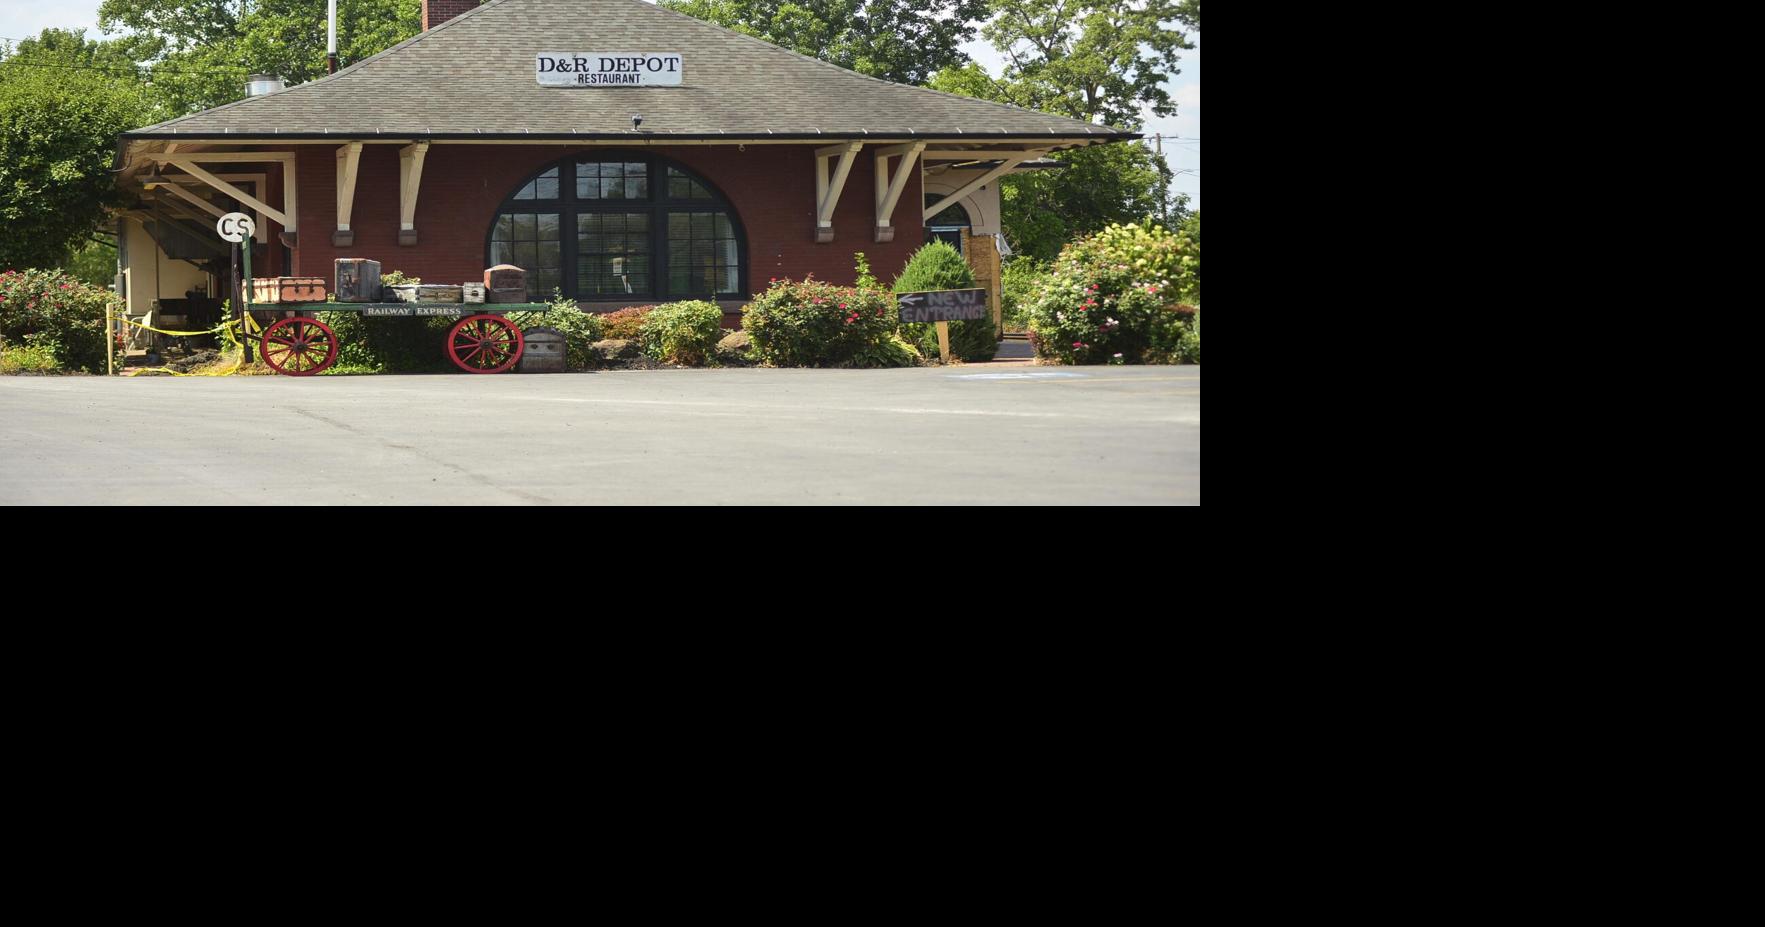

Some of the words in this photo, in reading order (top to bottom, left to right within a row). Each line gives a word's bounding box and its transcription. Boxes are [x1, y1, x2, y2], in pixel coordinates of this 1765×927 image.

[538, 57, 589, 73] D&R
[598, 57, 679, 73] DEPOT
[577, 73, 641, 84] RESTAURANT
[927, 290, 977, 307] NEW
[367, 307, 410, 315] RAILWAY
[417, 307, 461, 315] EXPRESS
